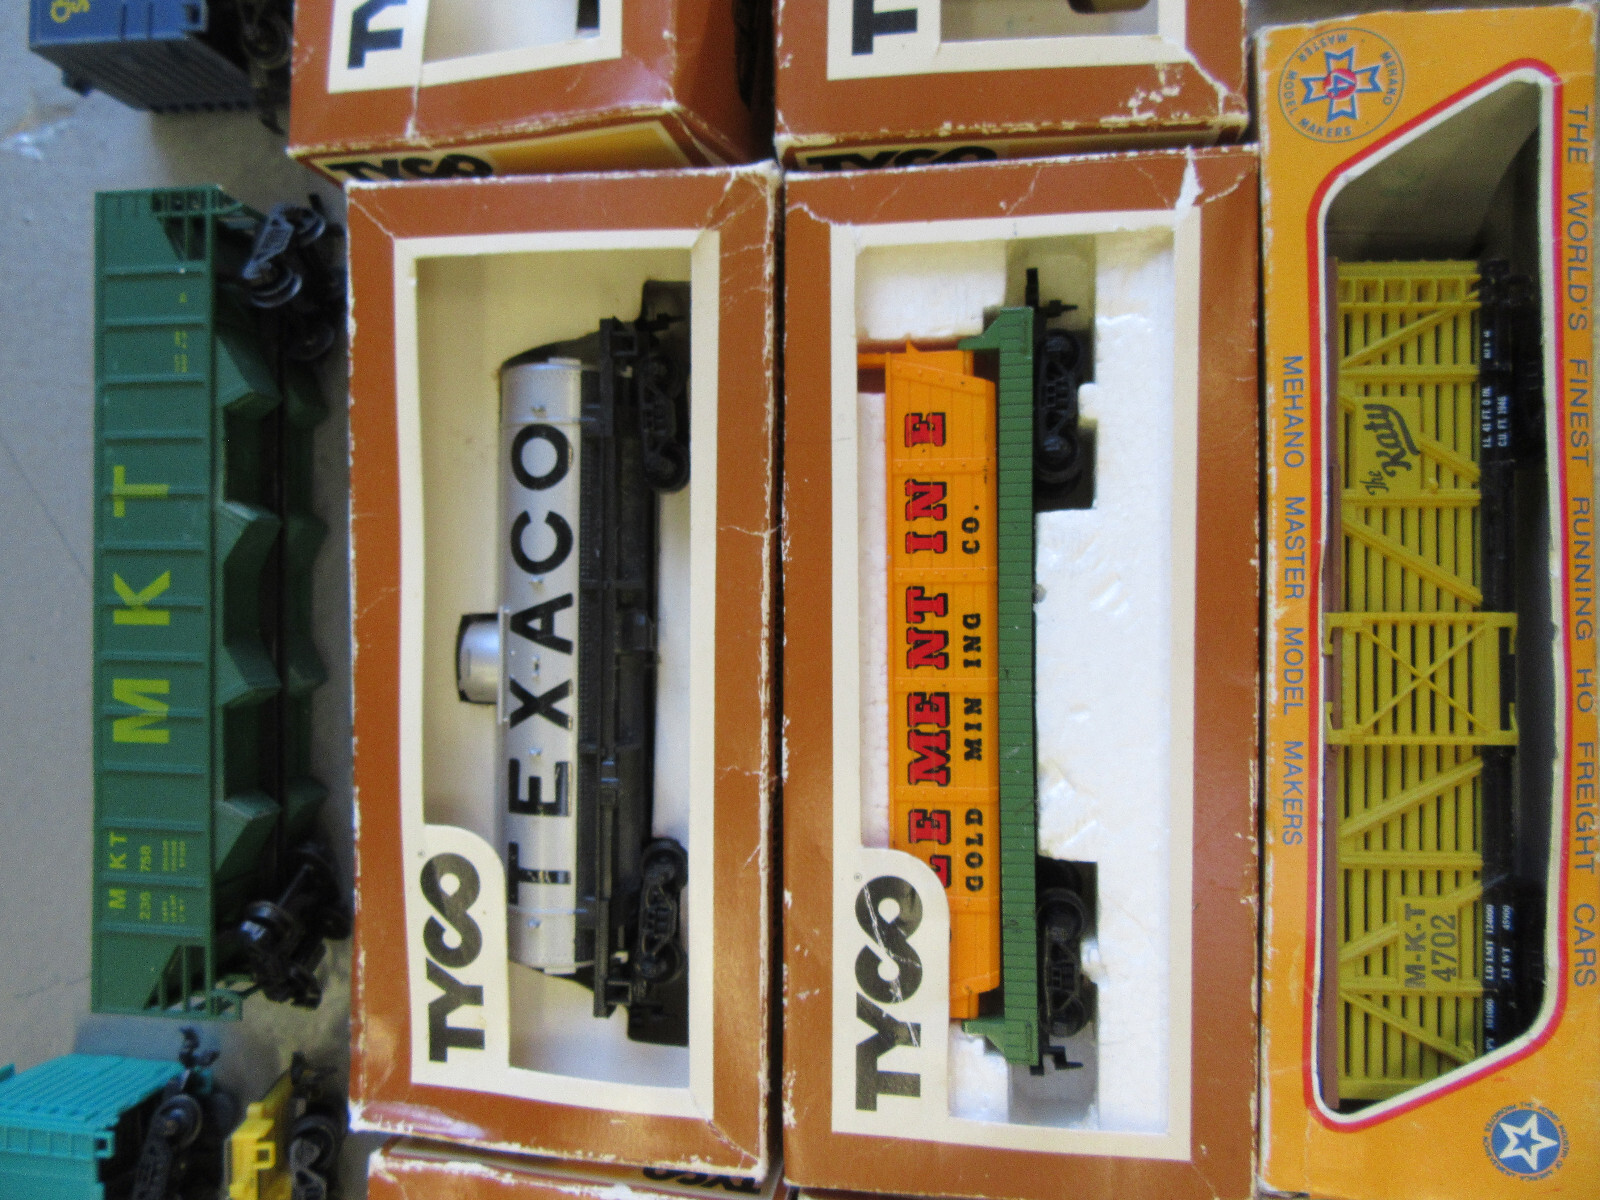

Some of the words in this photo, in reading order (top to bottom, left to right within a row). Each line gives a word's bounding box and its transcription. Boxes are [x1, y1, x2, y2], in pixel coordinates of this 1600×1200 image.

[1298, 33, 1348, 62] MASTER
[1380, 51, 1400, 106] MEHANO
[1283, 69, 1299, 115] MODEL
[1298, 117, 1352, 138] MAKERS
[1567, 105, 1589, 163] THE
[1567, 191, 1589, 331] WORLD'S
[1283, 355, 1306, 468] MEHANO
[1362, 403, 1421, 477] Katy
[1569, 358, 1589, 467] FINEST
[1359, 470, 1389, 496] The
[961, 505, 980, 555] CO.
[1284, 496, 1307, 599] MASTER
[1573, 496, 1593, 640] RUNNING
[507, 424, 571, 905] TEXACO
[904, 412, 952, 889] LEMENTINE
[1283, 627, 1305, 715] MODEL
[1575, 668, 1594, 713] HO
[1282, 740, 1305, 847] MAKERS
[1574, 742, 1595, 873] FREIGHT
[963, 808, 984, 892] GOLD
[420, 852, 485, 1063] TYCO
[1404, 903, 1426, 989] M-K-T
[1430, 914, 1457, 983] 4702
[1485, 903, 1494, 935] 124000
[1485, 939, 1494, 963] LMT
[1501, 946, 1510, 964] WT
[1573, 903, 1596, 987] CARS
[855, 875, 923, 1112] TYCO
[1485, 965, 1494, 980] LD
[1501, 966, 1510, 979] LT
